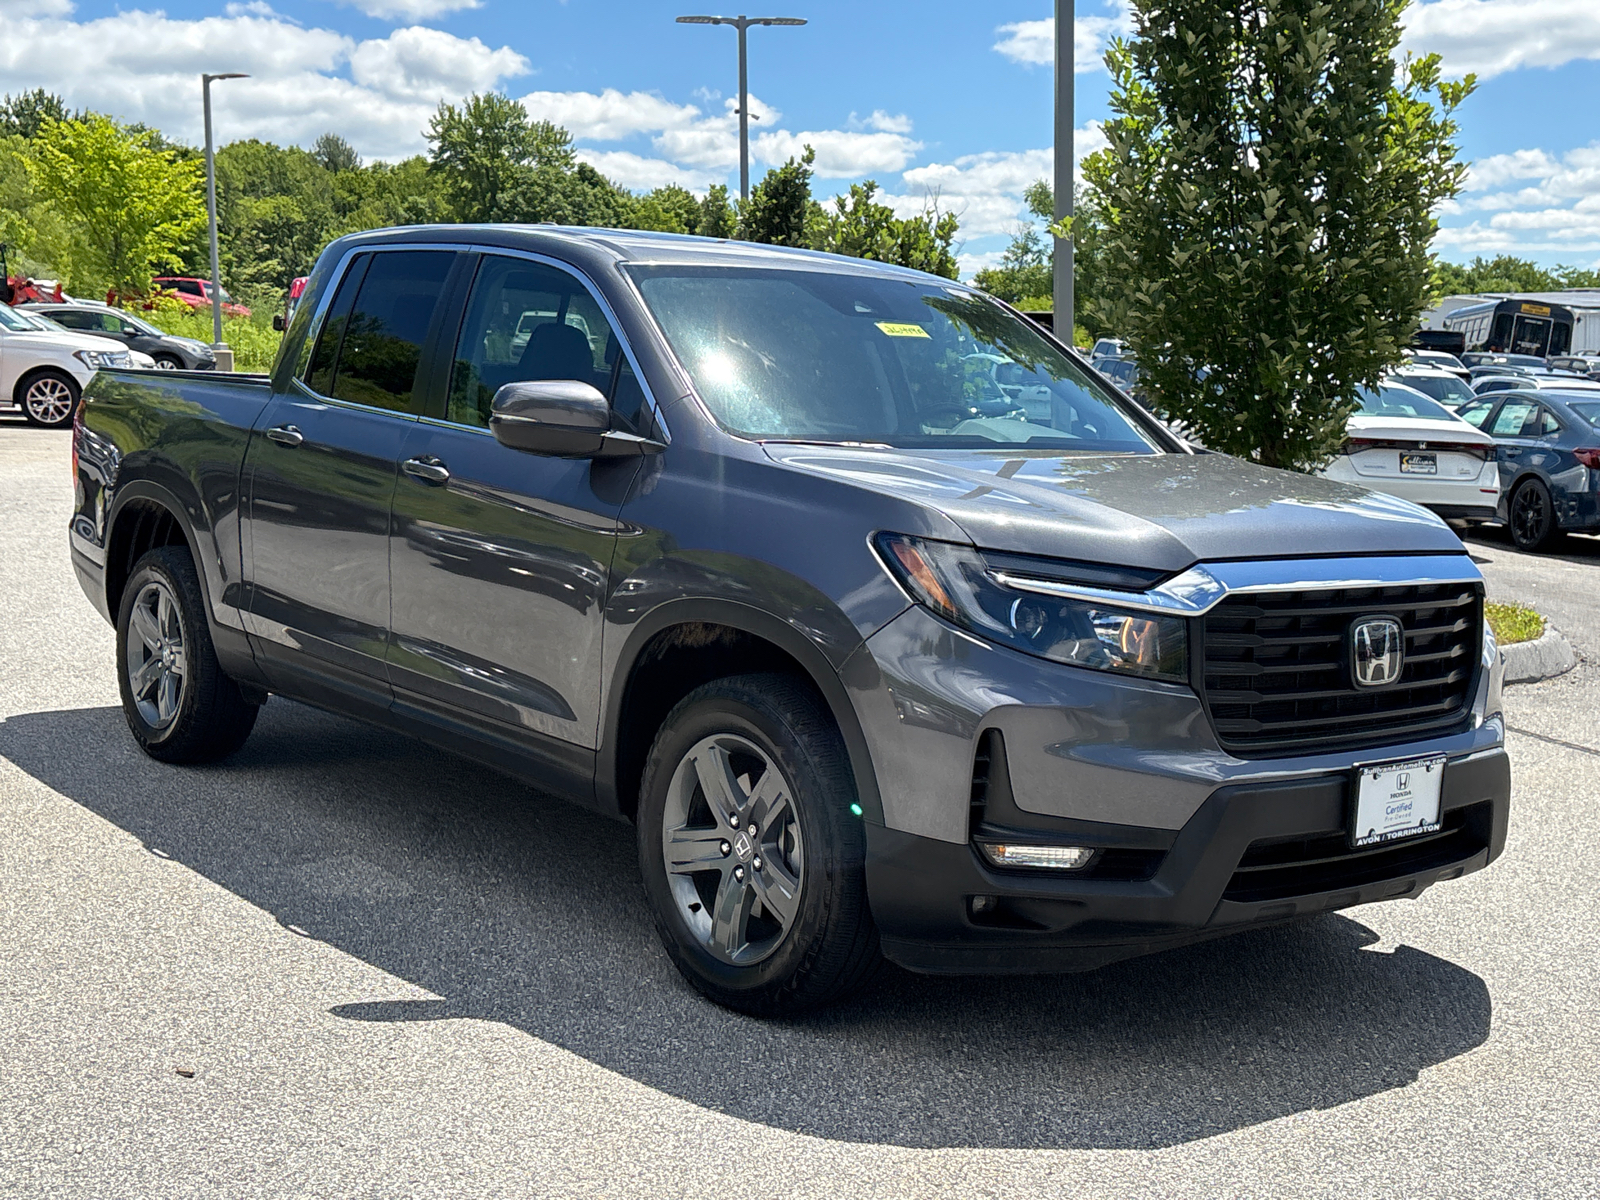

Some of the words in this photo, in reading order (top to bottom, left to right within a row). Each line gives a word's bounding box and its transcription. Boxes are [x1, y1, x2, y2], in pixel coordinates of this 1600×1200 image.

[1402, 456, 1434, 469] Sullivan
[1390, 790, 1412, 799] HONDA
[1386, 801, 1412, 815] Certified
[1357, 835, 1380, 846] AVON
[1386, 824, 1440, 840] TORRINGTON
